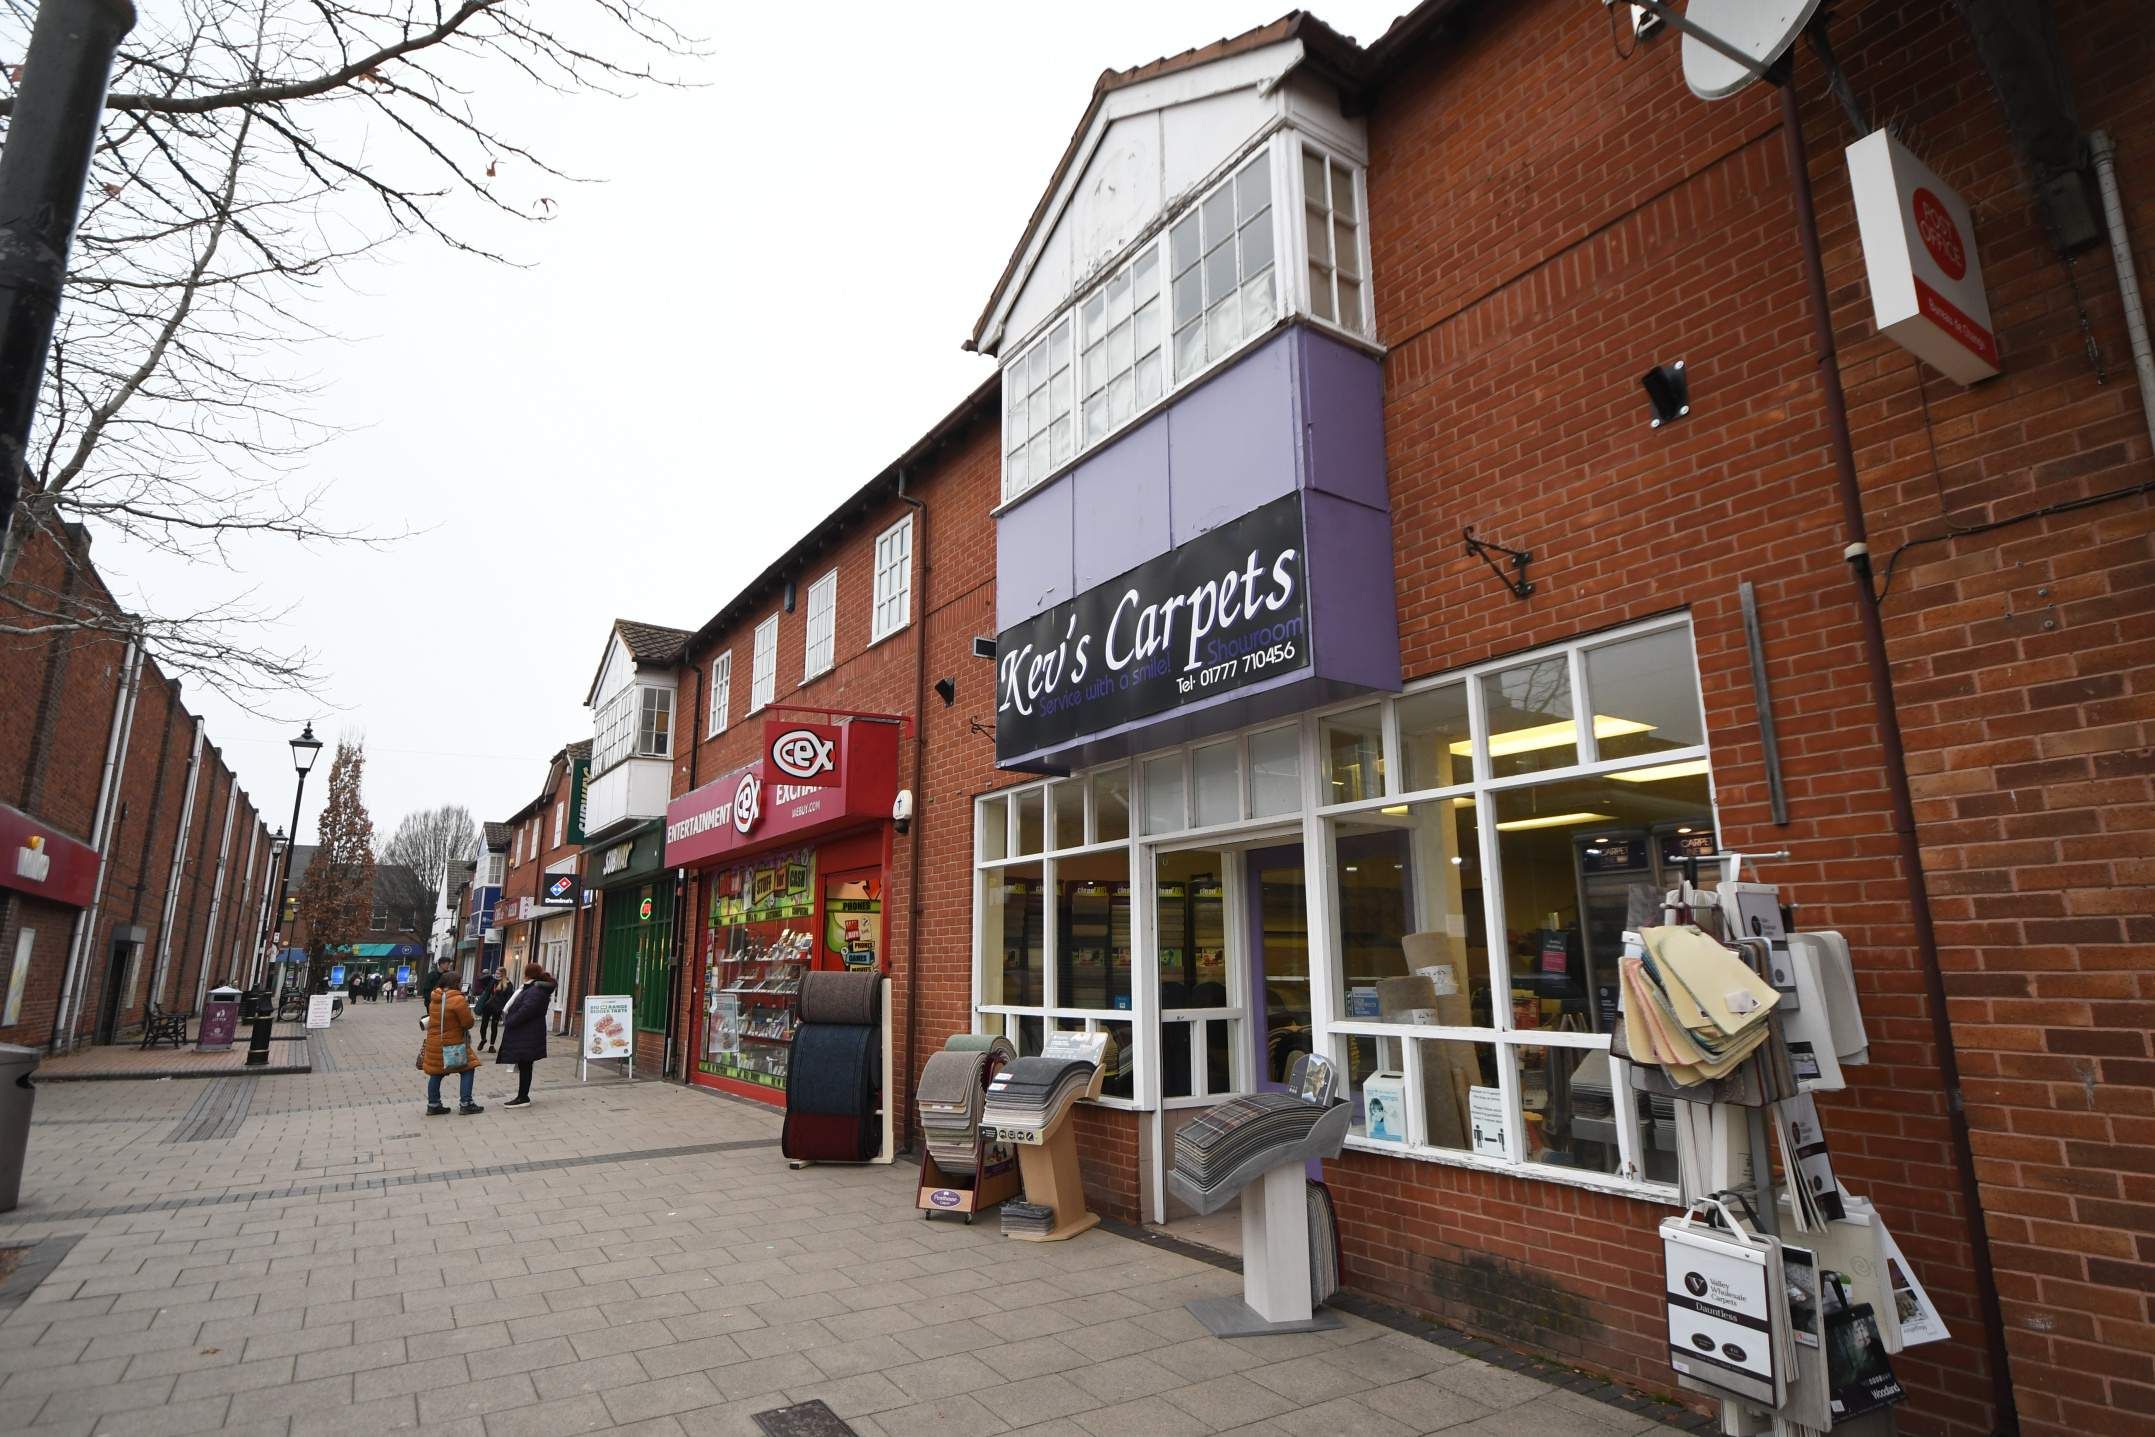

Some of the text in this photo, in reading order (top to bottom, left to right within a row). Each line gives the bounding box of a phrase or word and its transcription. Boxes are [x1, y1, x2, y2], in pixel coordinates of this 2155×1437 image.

[999, 549, 1298, 716] Kev's Carpets
[1206, 617, 1303, 665] Showroom
[1200, 660, 1238, 686] 01777
[1242, 641, 1296, 673] 710456
[1039, 652, 1172, 718] Service with a smile!
[667, 803, 732, 844] ENTERTAINMENT
[791, 800, 821, 818] WEBUY.COM
[602, 840, 633, 876] SUBWAY
[843, 901, 871, 911] PHONES
[1696, 1301, 1738, 1323] Dauntless
[1870, 1382, 1901, 1400] Woodland
